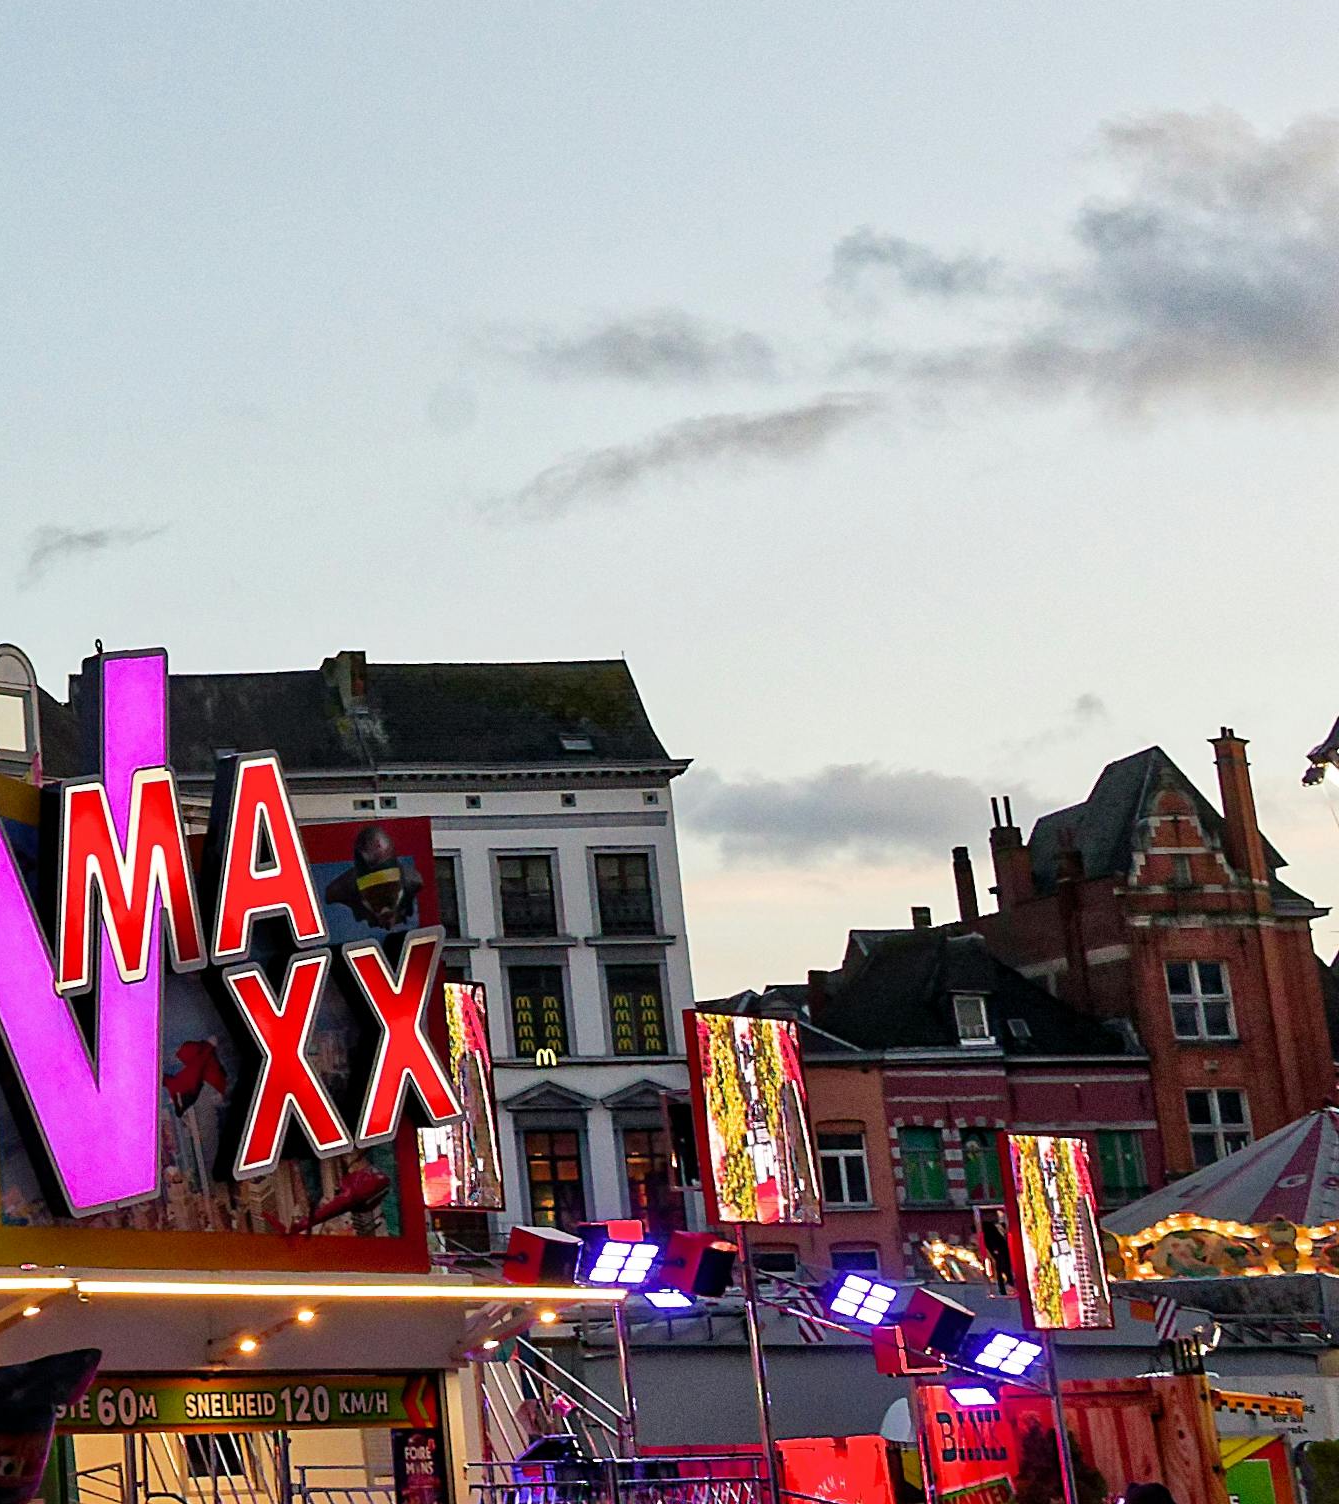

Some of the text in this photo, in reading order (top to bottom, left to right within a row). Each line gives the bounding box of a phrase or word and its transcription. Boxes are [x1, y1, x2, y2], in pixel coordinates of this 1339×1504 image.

[185, 1392, 276, 1418] SNELHEID
[281, 1386, 330, 1423] 120
[338, 1391, 389, 1415] KM/H
